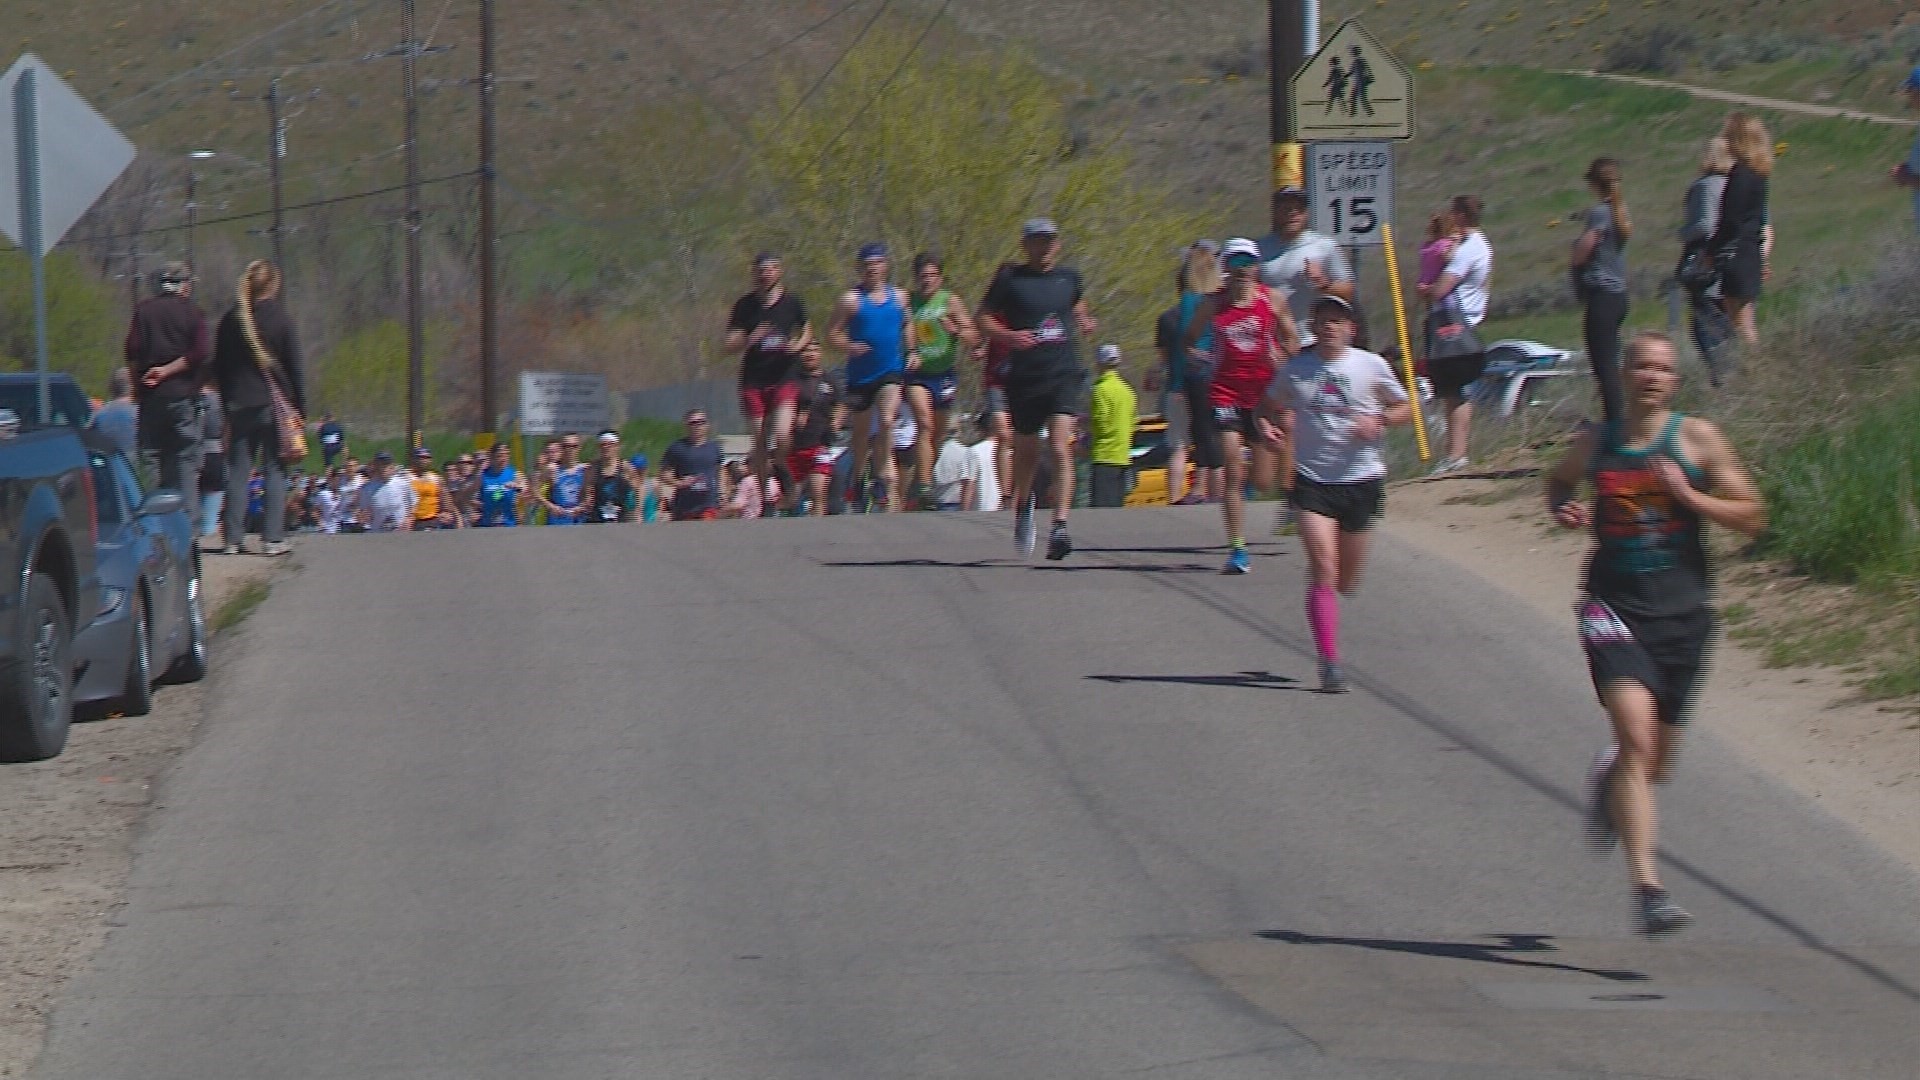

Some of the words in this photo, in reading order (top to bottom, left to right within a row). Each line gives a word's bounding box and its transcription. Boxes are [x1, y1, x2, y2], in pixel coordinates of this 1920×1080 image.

[1319, 152, 1387, 171] SPEED
[1325, 174, 1378, 192] LIMIT
[1328, 196, 1377, 234] 15
